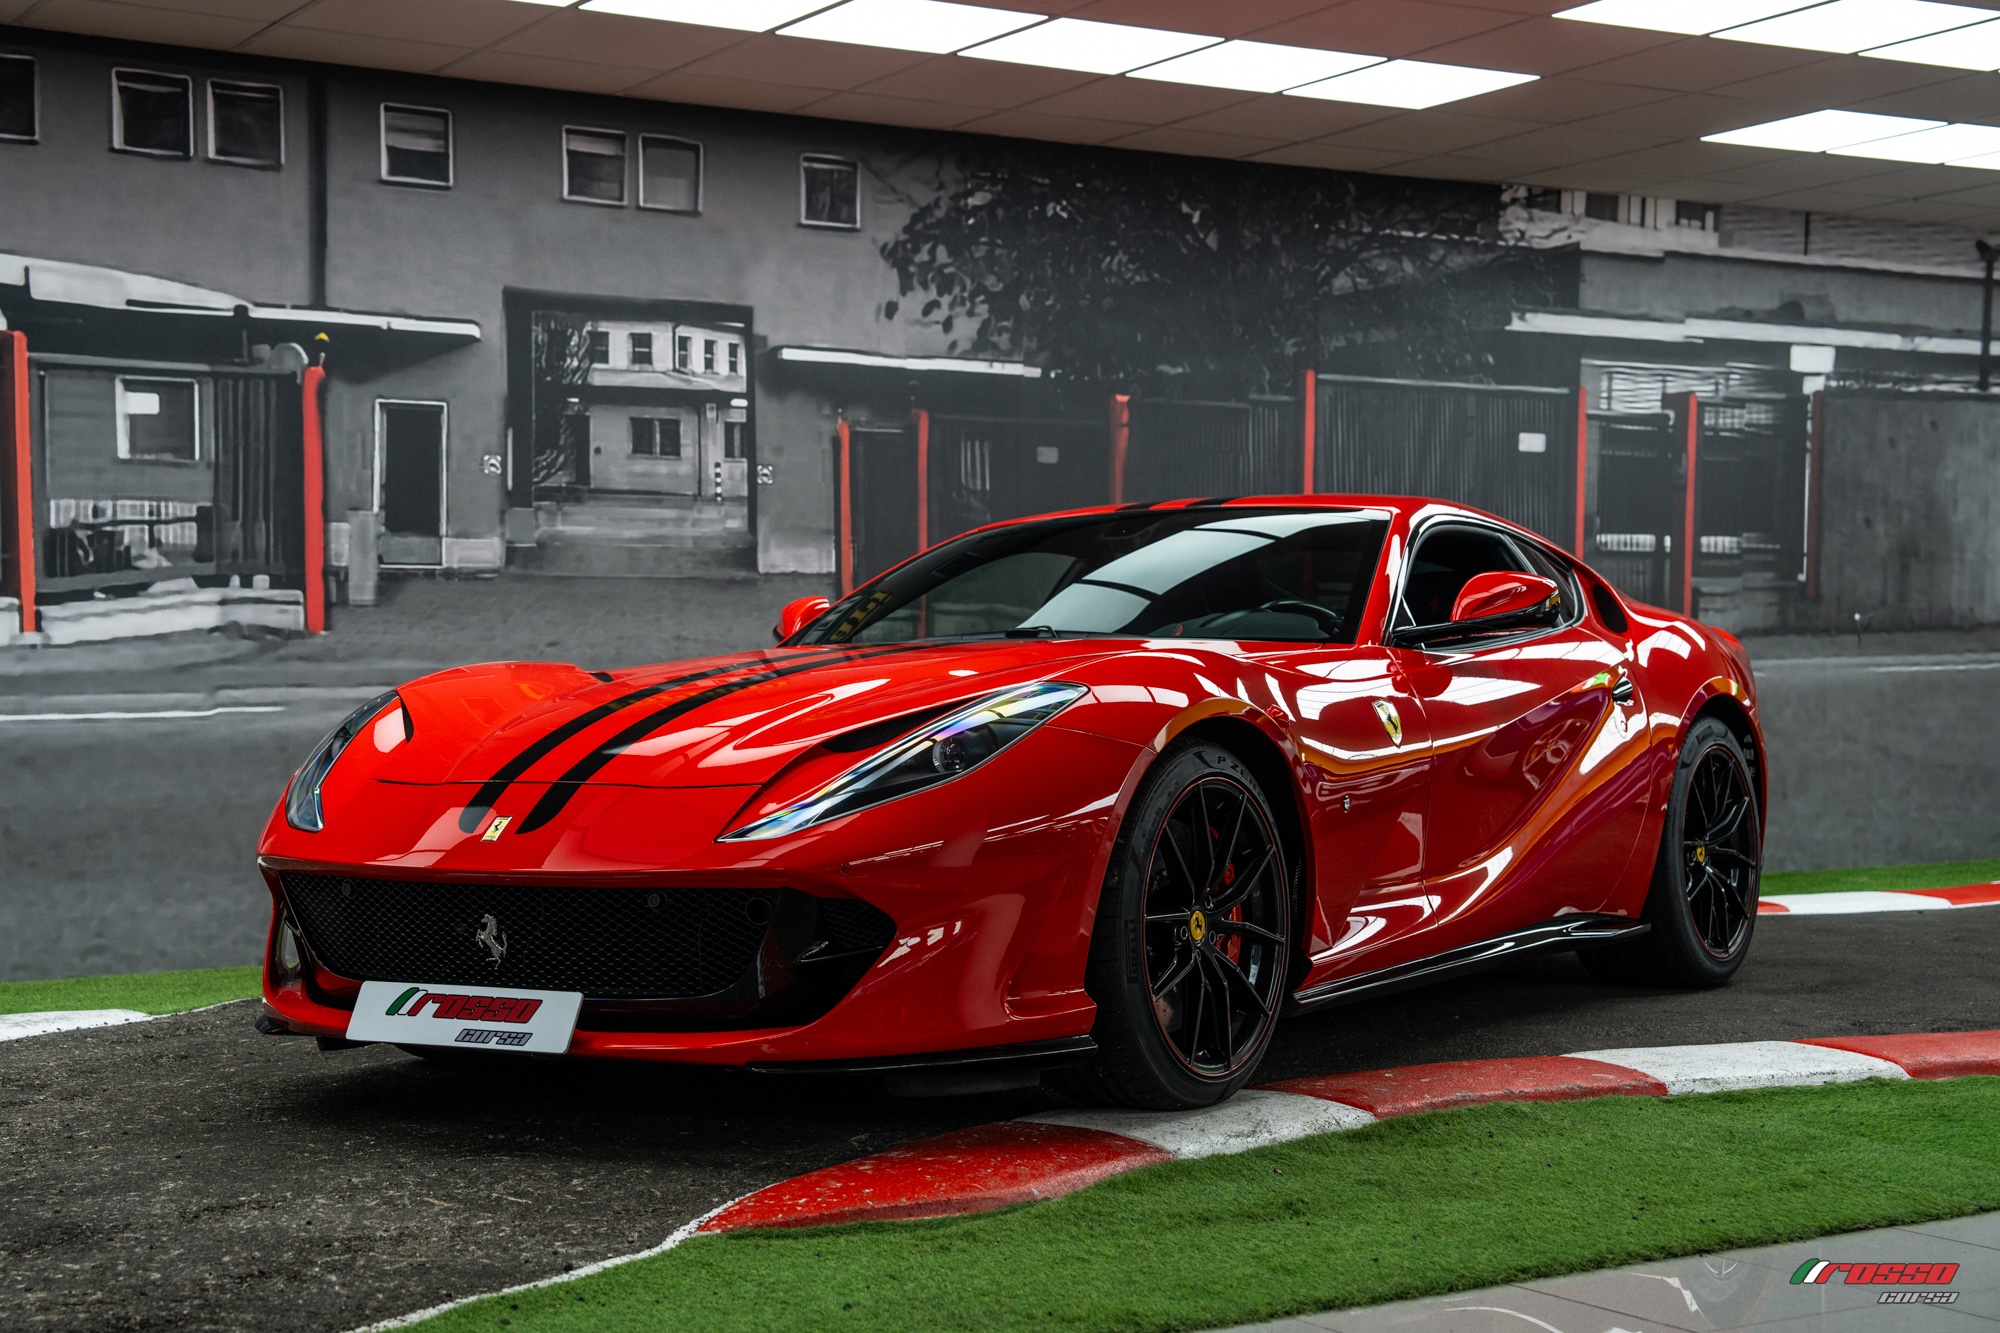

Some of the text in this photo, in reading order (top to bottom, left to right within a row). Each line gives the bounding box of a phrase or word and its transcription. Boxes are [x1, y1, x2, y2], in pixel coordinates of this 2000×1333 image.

[1217, 755, 1226, 764] P
[407, 993, 543, 1024] rosso
[455, 1028, 533, 1046] corsa
